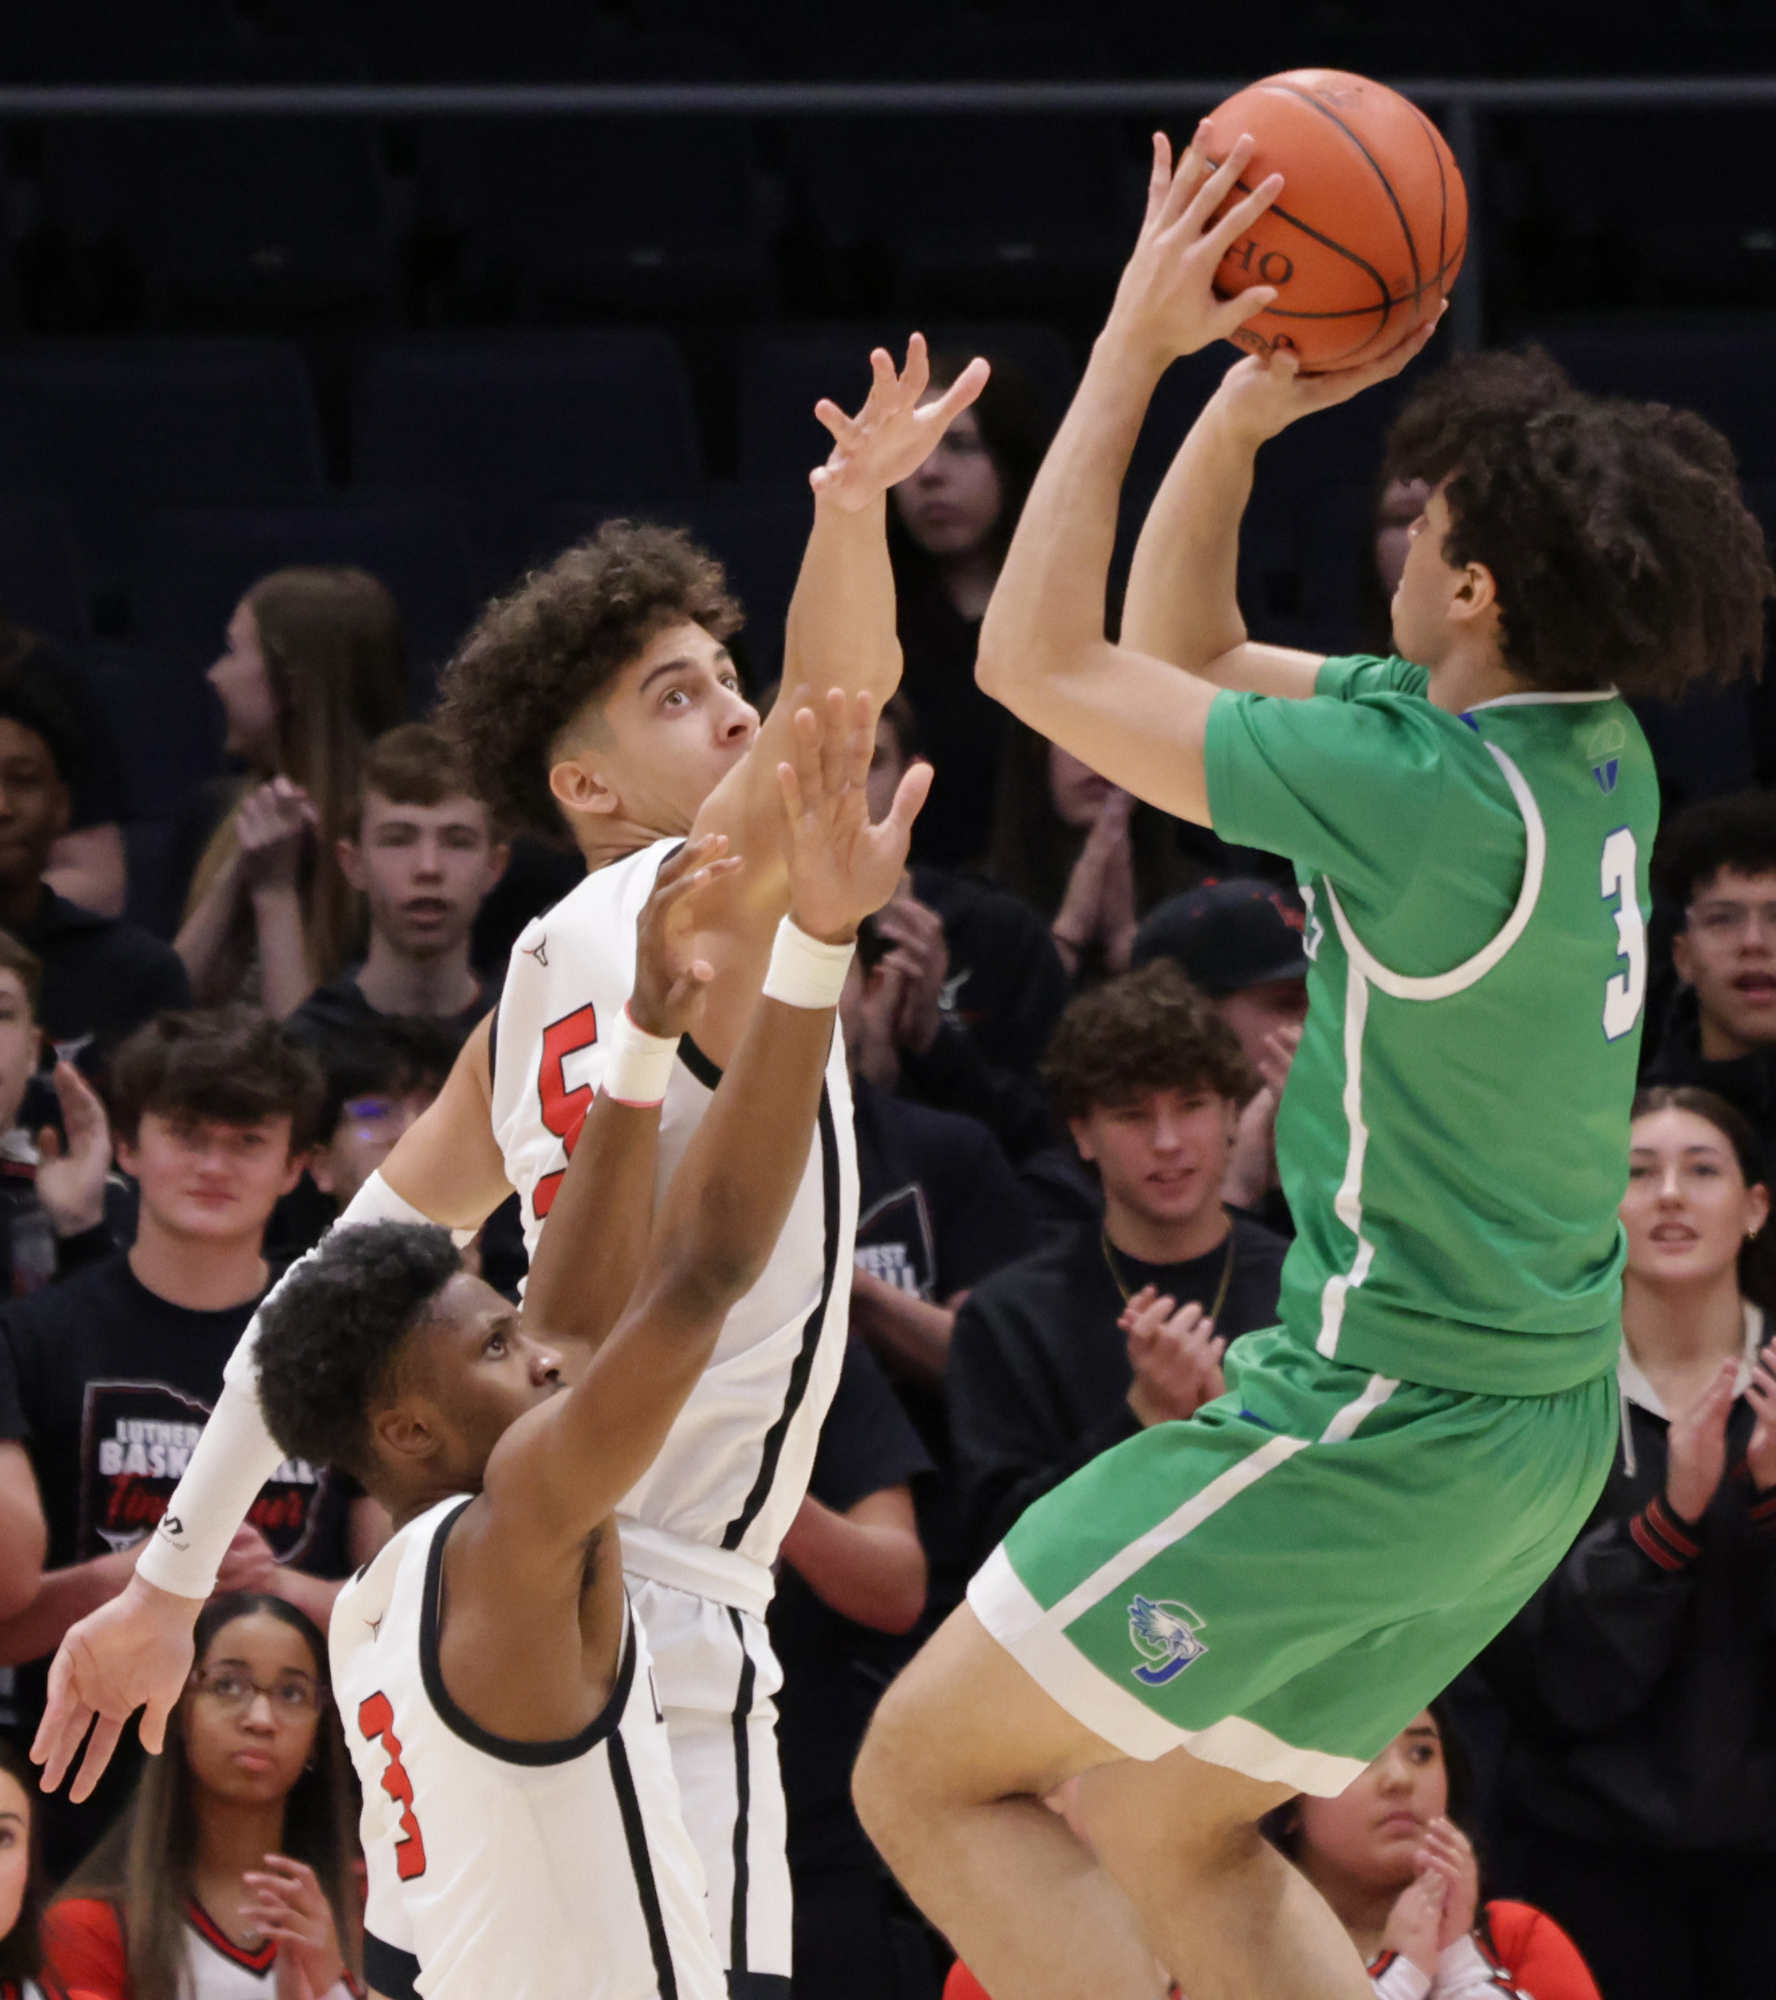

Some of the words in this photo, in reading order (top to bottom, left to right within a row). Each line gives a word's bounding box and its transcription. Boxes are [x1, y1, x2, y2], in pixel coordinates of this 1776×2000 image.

[1601, 825, 1647, 1043] 3
[532, 1002, 598, 1221] 5
[115, 1418, 203, 1446] LUTHER
[359, 1690, 427, 1882] 3
